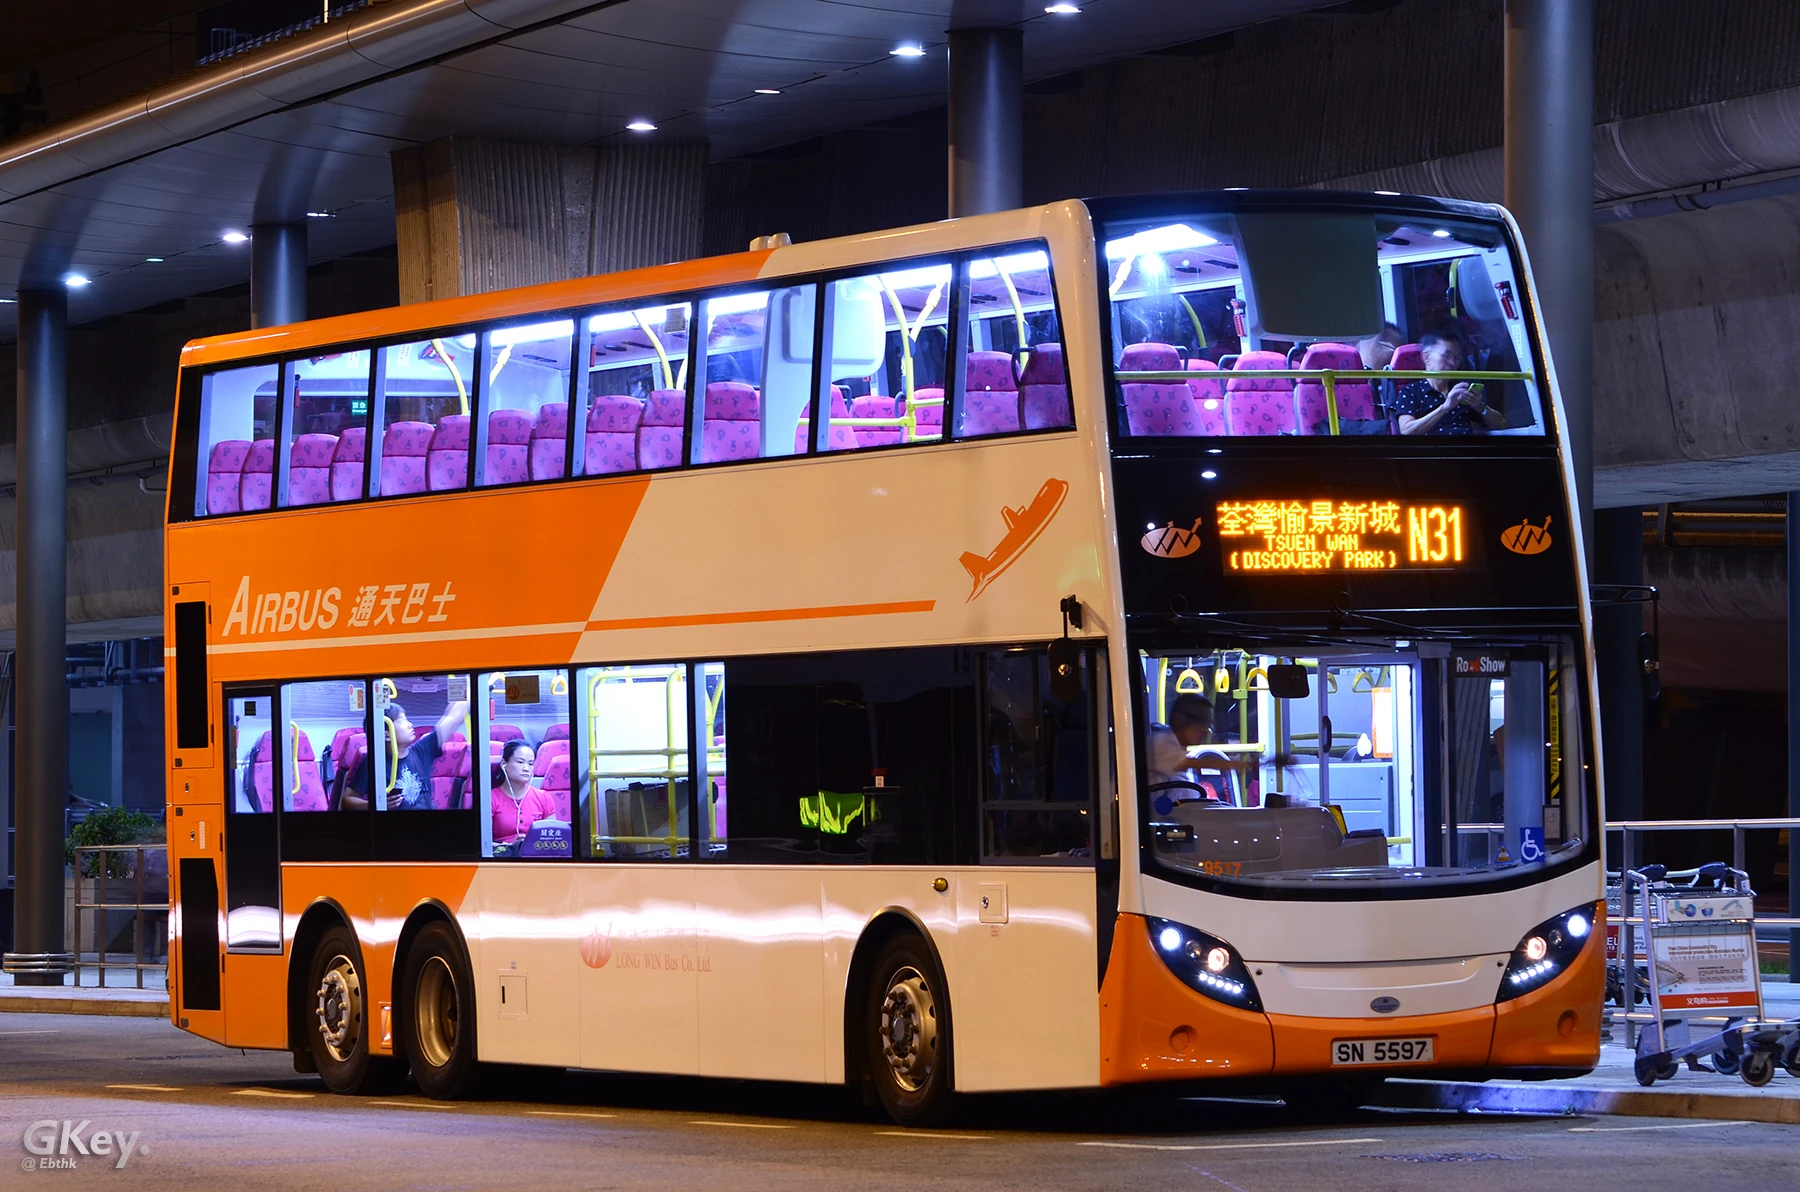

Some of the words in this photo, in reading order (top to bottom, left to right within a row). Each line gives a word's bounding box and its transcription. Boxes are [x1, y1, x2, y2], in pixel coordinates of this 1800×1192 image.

[1216, 501, 1401, 535] 荃灣愉景新城
[1263, 534, 1316, 551] TSUEN
[1326, 534, 1359, 551] WAN
[1408, 506, 1462, 562] N31
[1230, 551, 1334, 569] (DISCOVERY
[1344, 551, 1397, 569] PARK)
[222, 575, 342, 637] AIRBUS
[347, 581, 456, 628] 通天巴士
[1204, 860, 1242, 877] 9517
[616, 952, 640, 969] LONG
[644, 952, 661, 970] WIN
[664, 953, 678, 971] Bus
[681, 954, 694, 972] Co.
[697, 955, 713, 973] Ltd.
[1337, 1043, 1364, 1062] SN
[1374, 1040, 1427, 1061] 5597
